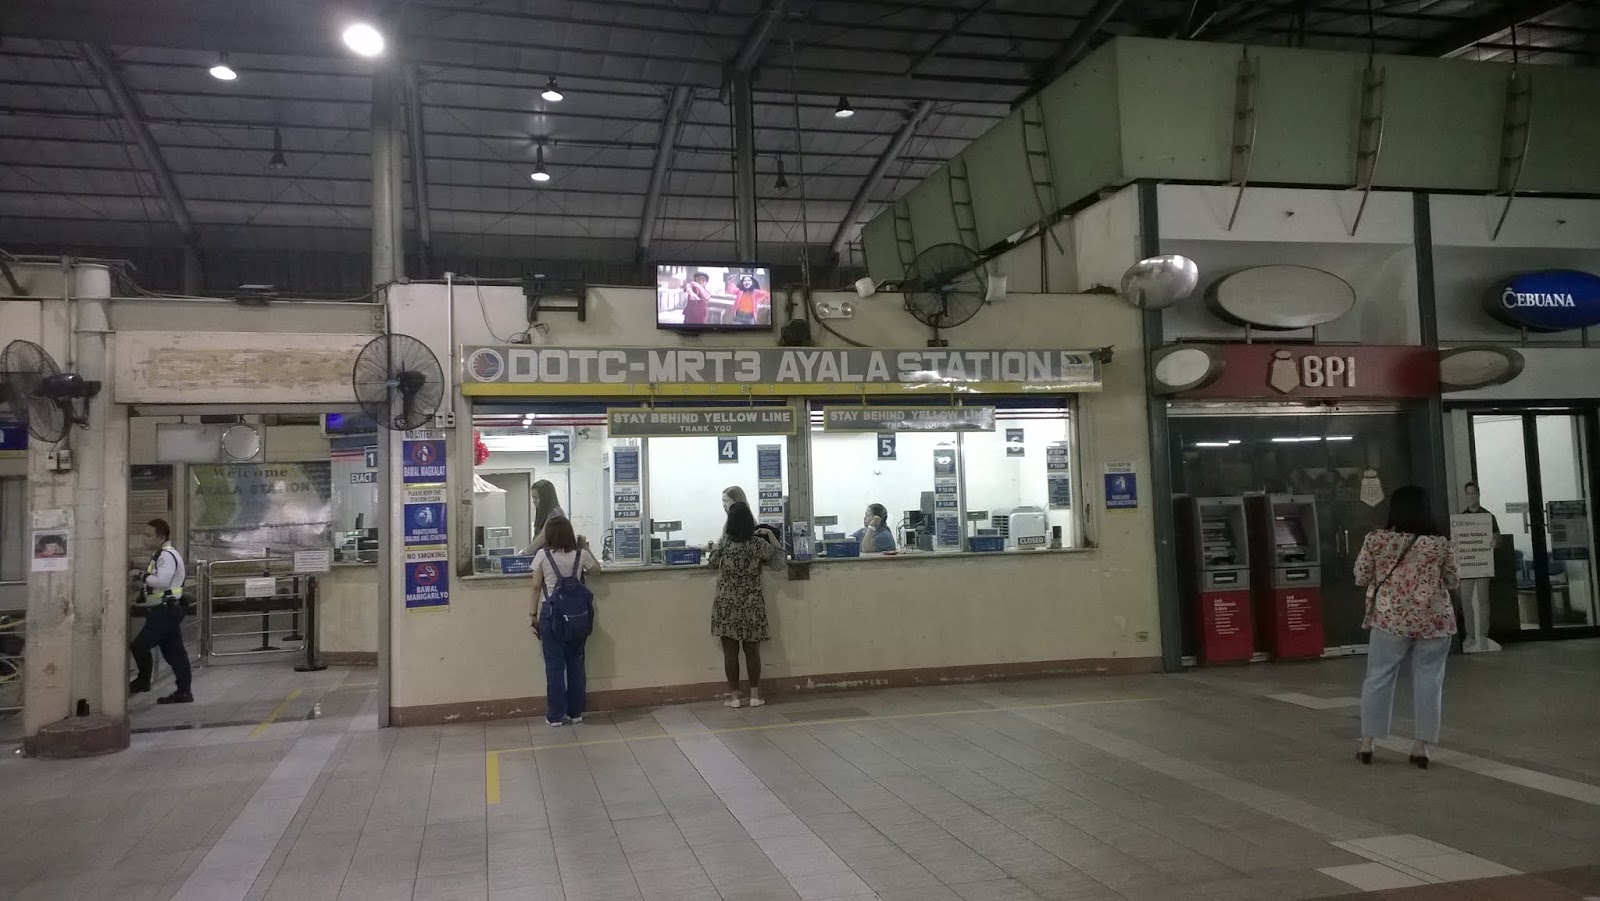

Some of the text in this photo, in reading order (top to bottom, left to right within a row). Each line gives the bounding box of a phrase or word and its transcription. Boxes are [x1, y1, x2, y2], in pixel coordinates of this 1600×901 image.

[1502, 287, 1575, 309] CEBUANA
[508, 349, 761, 383] DOTC-MRT3
[775, 350, 890, 382] AYALA
[897, 351, 1051, 382] STATION
[1303, 355, 1355, 387] BPI
[613, 412, 791, 424] STAY BEHIND YELLOW LINE
[830, 411, 859, 421] STAY
[863, 411, 905, 420] BEHIND
[911, 410, 958, 420] YELLOW
[405, 430, 413, 439] NO
[553, 443, 565, 462] 3
[722, 441, 734, 459] 4
[882, 439, 892, 456] 5
[368, 454, 375, 466] 1
[213, 467, 288, 478] Welcome
[351, 473, 373, 483] EXACT
[1020, 536, 1044, 544] CLOSED
[417, 551, 446, 559] SMOKING
[416, 585, 438, 593] BAWAL
[406, 591, 449, 602] MANIGARILYO
